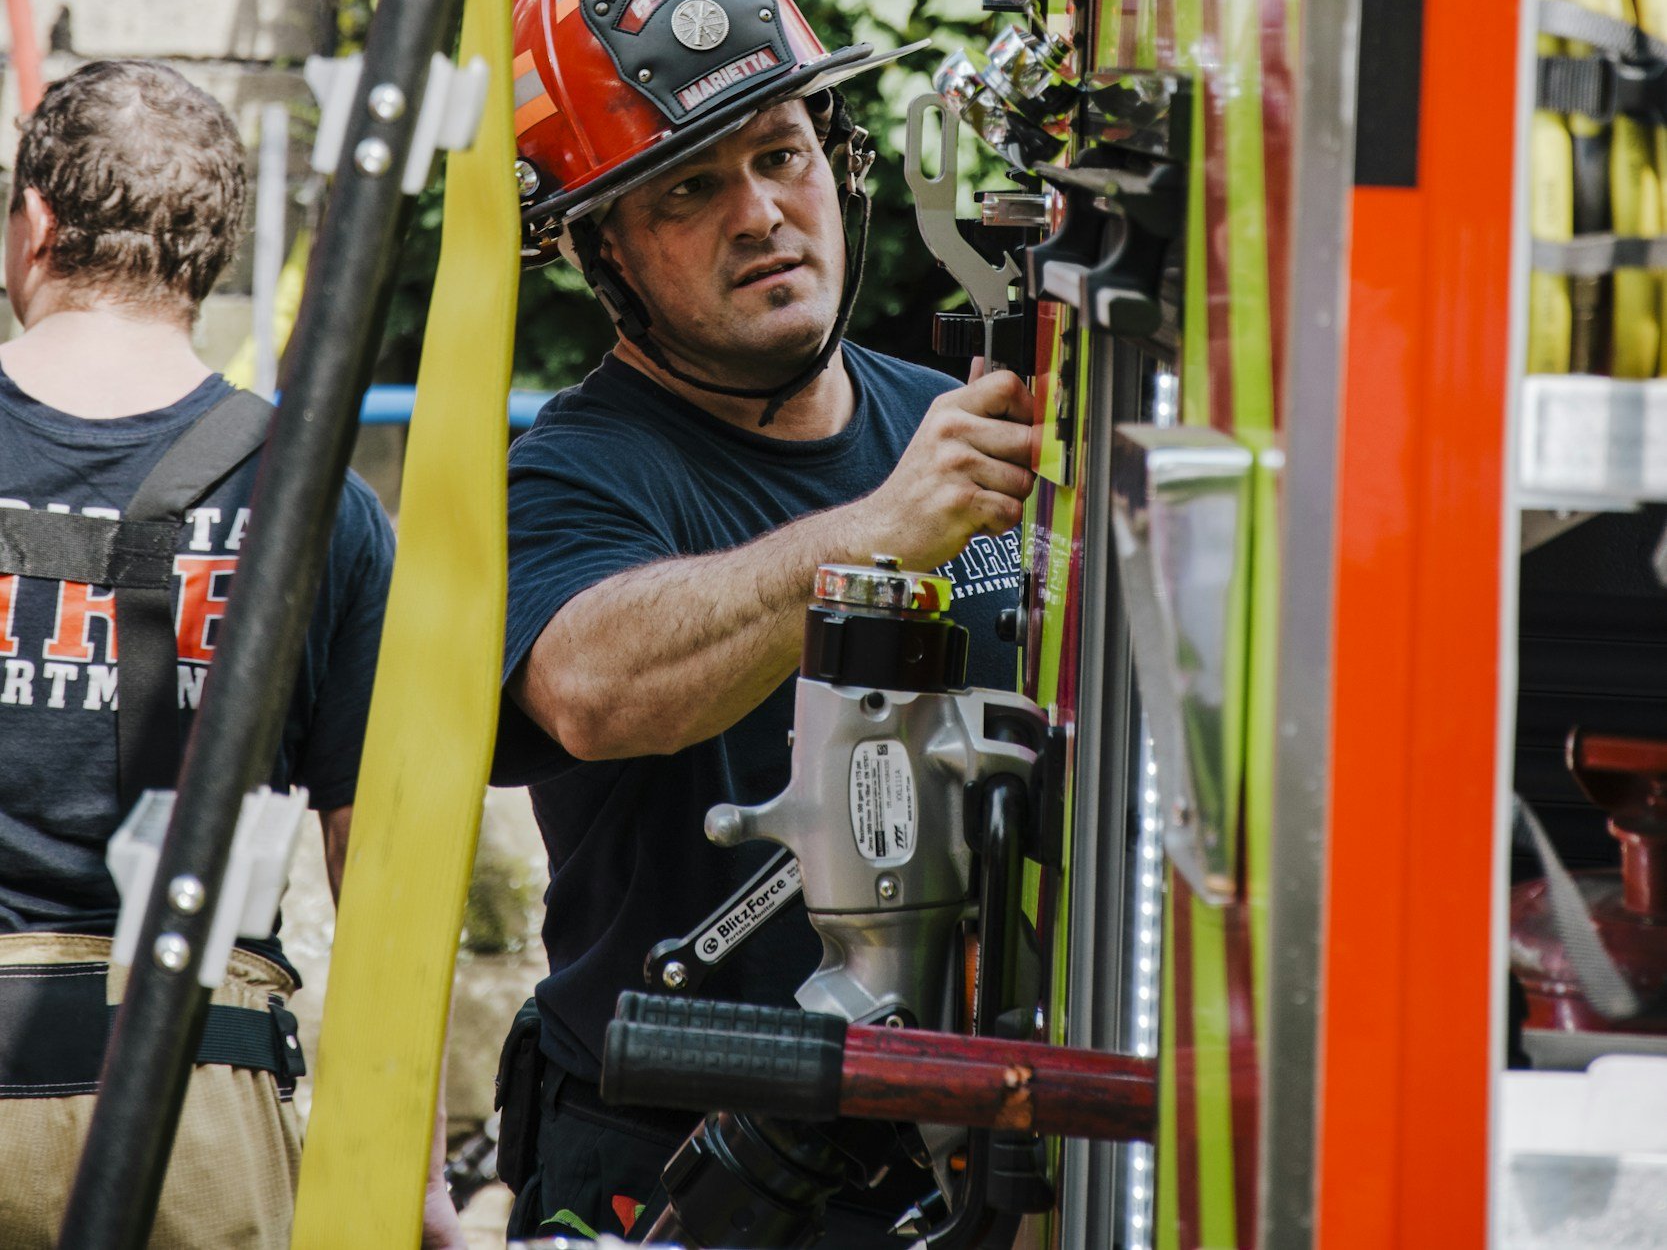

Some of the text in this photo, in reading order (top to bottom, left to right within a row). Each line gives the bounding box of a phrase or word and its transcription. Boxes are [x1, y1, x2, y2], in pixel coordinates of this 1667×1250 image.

[680, 51, 776, 112] MARIETTA
[950, 575, 1020, 601] EPARTME
[716, 879, 787, 938] BlitzForce
[725, 901, 776, 945] Portable Monitor
